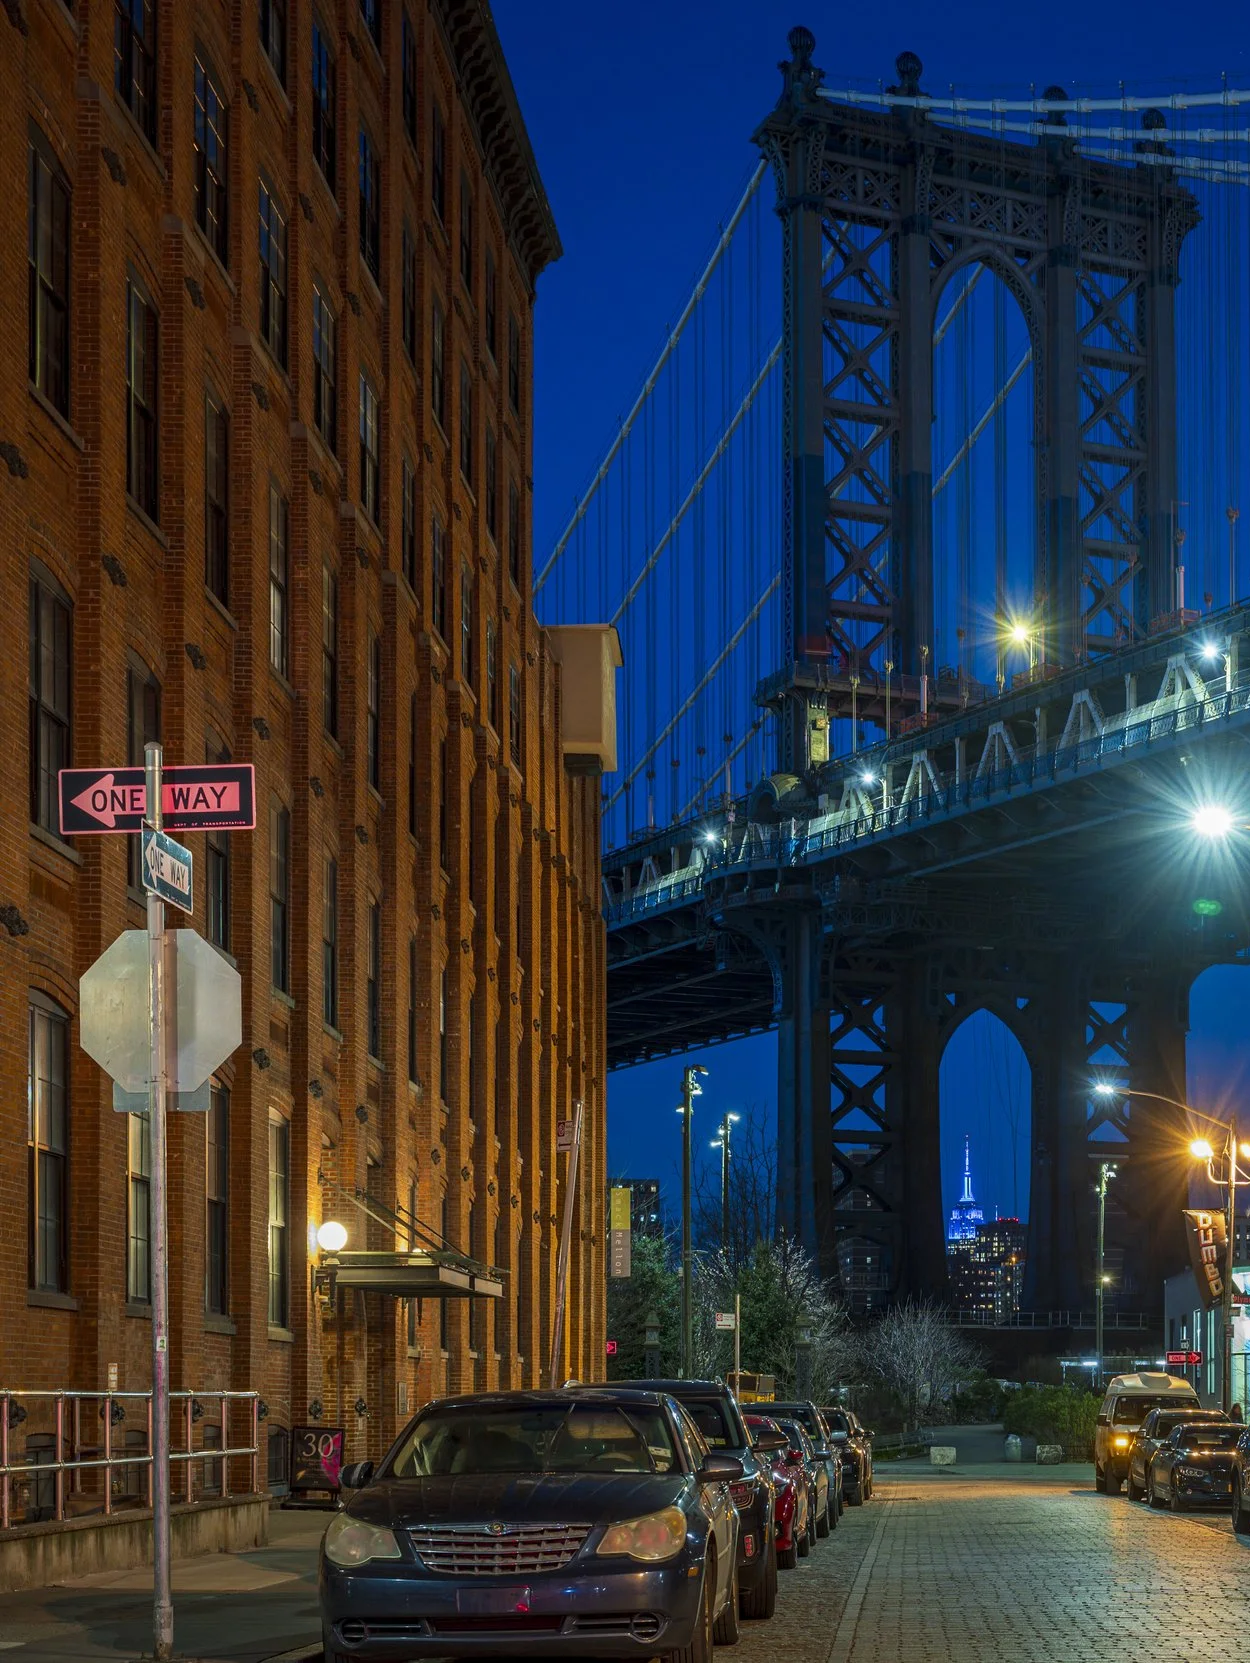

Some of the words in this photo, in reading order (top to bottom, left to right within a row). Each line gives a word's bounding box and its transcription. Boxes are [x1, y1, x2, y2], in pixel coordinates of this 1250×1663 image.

[91, 788, 145, 812] ONE
[171, 786, 228, 810] WAY
[150, 846, 164, 877] ONE
[170, 859, 186, 890] WAY
[615, 1191, 624, 1230] Smack
[615, 1231, 623, 1275] Mellon
[1196, 1213, 1224, 1297] DUMBO
[302, 1433, 334, 1458] 30
